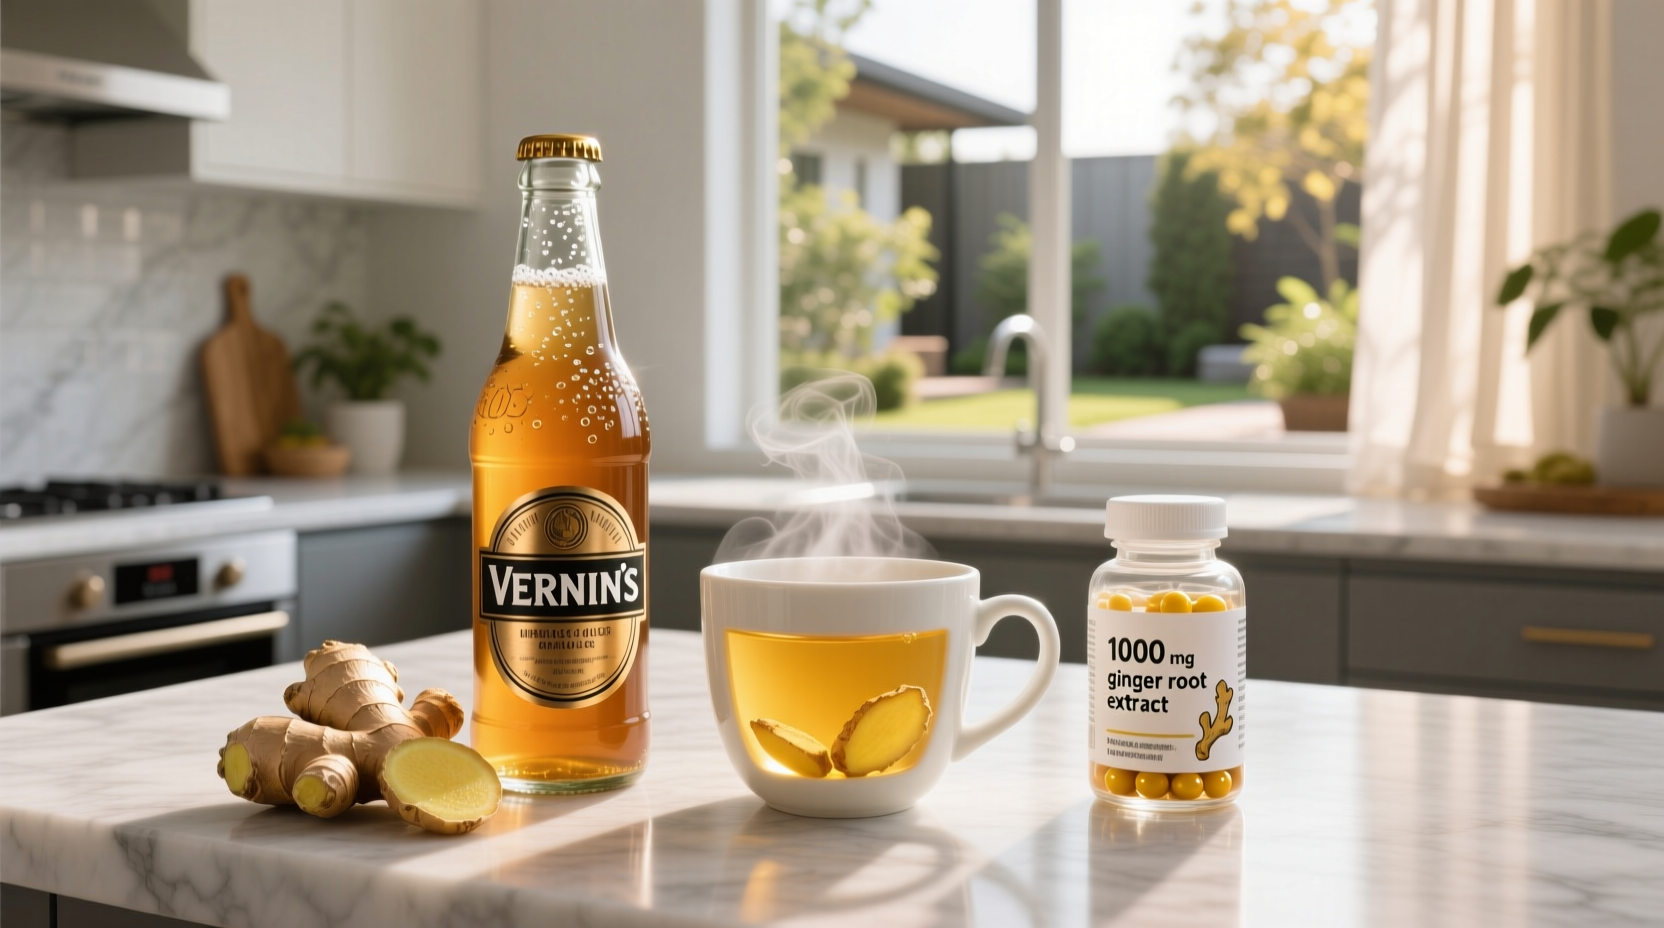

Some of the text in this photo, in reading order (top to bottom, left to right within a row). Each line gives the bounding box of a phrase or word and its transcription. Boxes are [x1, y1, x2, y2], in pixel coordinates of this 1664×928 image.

[488, 562, 639, 606] VERNIN'S
[1108, 636, 1195, 669] 1000 mg
[1107, 669, 1207, 693] ginger root
[1107, 694, 1169, 713] extract
